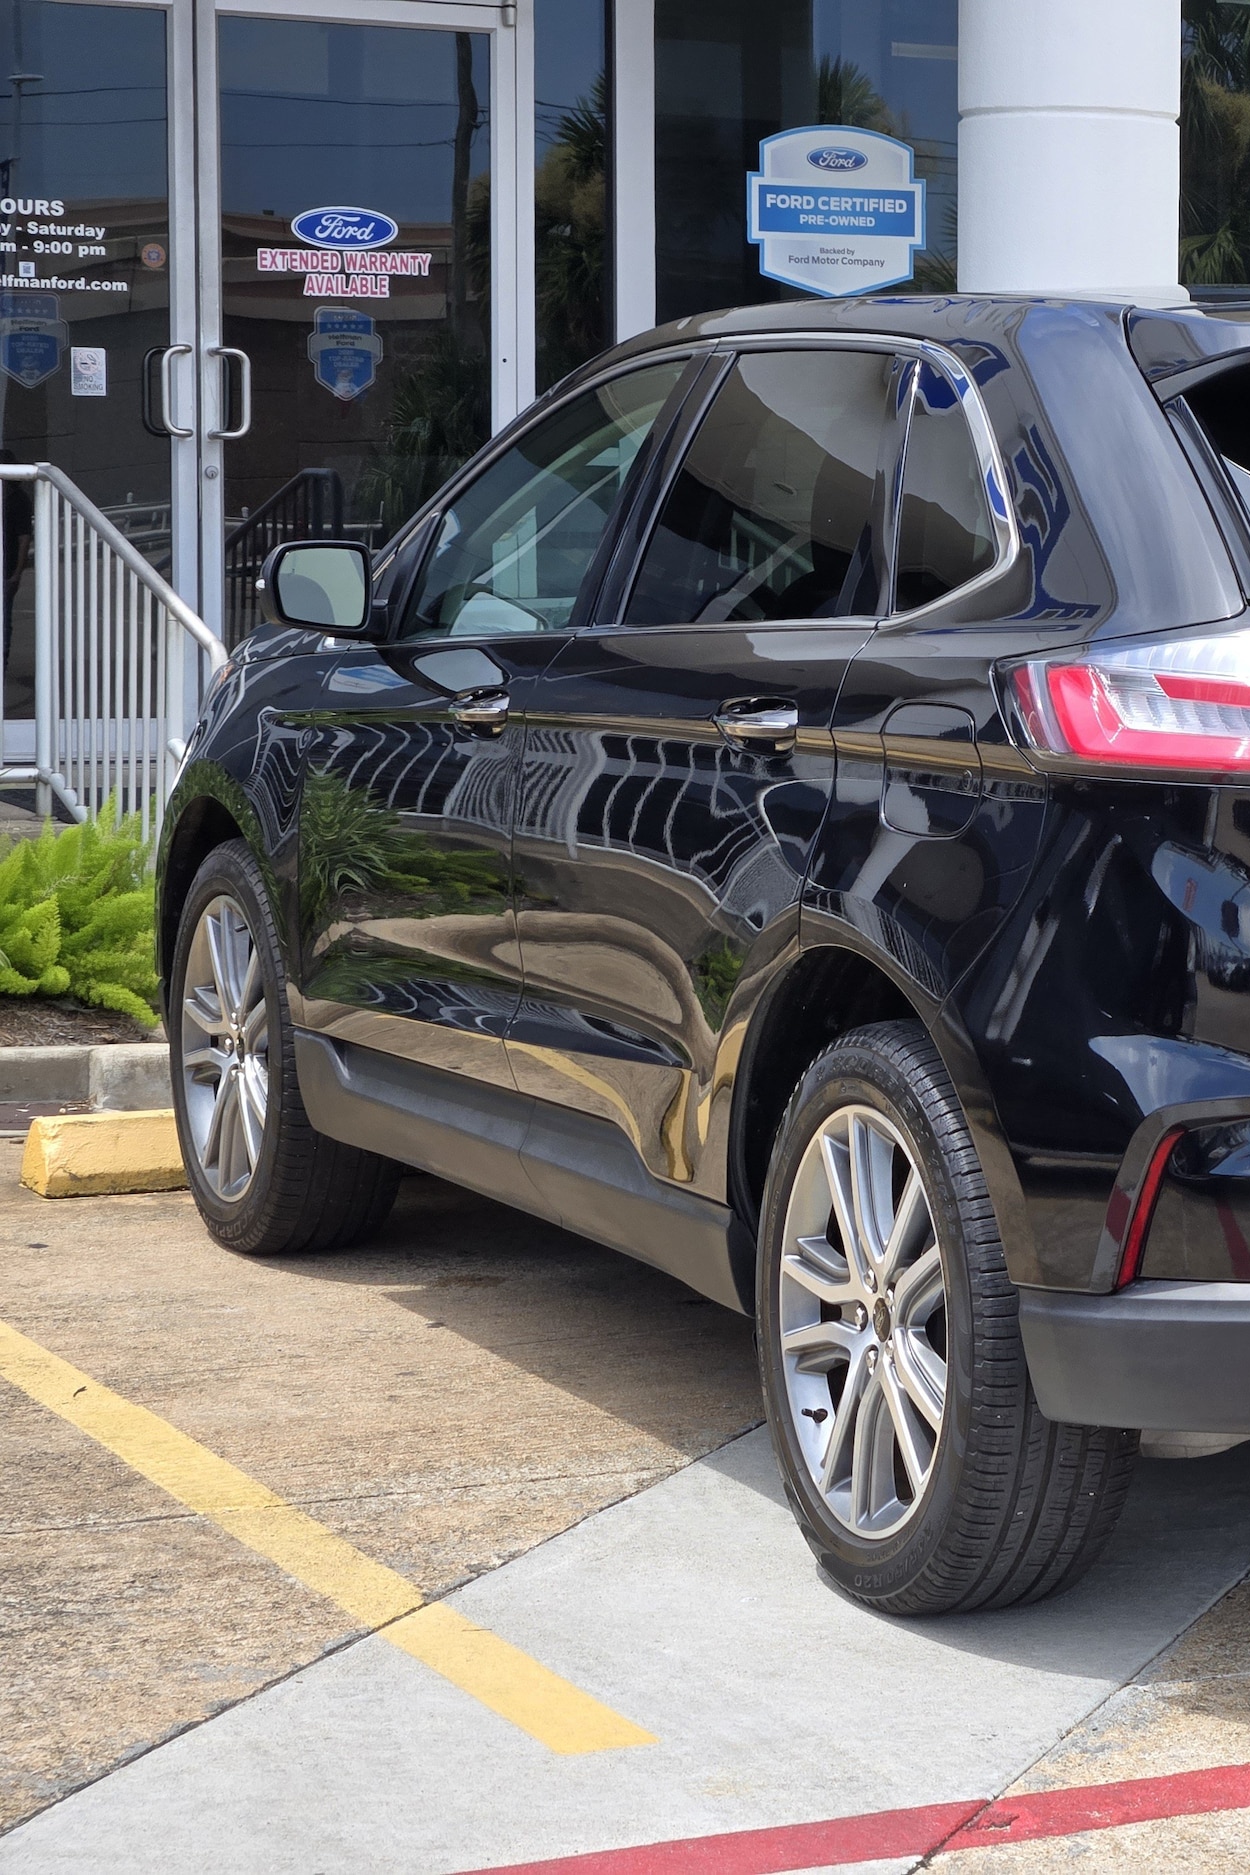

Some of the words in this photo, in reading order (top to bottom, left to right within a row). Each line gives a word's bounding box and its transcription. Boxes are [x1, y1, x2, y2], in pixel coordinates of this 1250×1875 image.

[819, 151, 855, 168] Ford
[766, 194, 815, 210] FORD
[817, 198, 907, 213] CERTIFIED
[315, 214, 375, 241] Ford
[799, 214, 876, 228] PRE-OWNED
[26, 221, 106, 241] Saturday
[33, 240, 73, 255] 9:00
[78, 245, 106, 258] pm
[819, 247, 845, 255] Backed
[847, 247, 856, 256] by
[258, 250, 340, 271] EXTENDED
[345, 253, 431, 275] WARRANTY
[788, 256, 810, 265] Ford
[811, 256, 840, 266] Motor
[841, 257, 886, 268] Company
[0, 274, 129, 292] lfmanford.com
[304, 276, 390, 297] AVAILABLE
